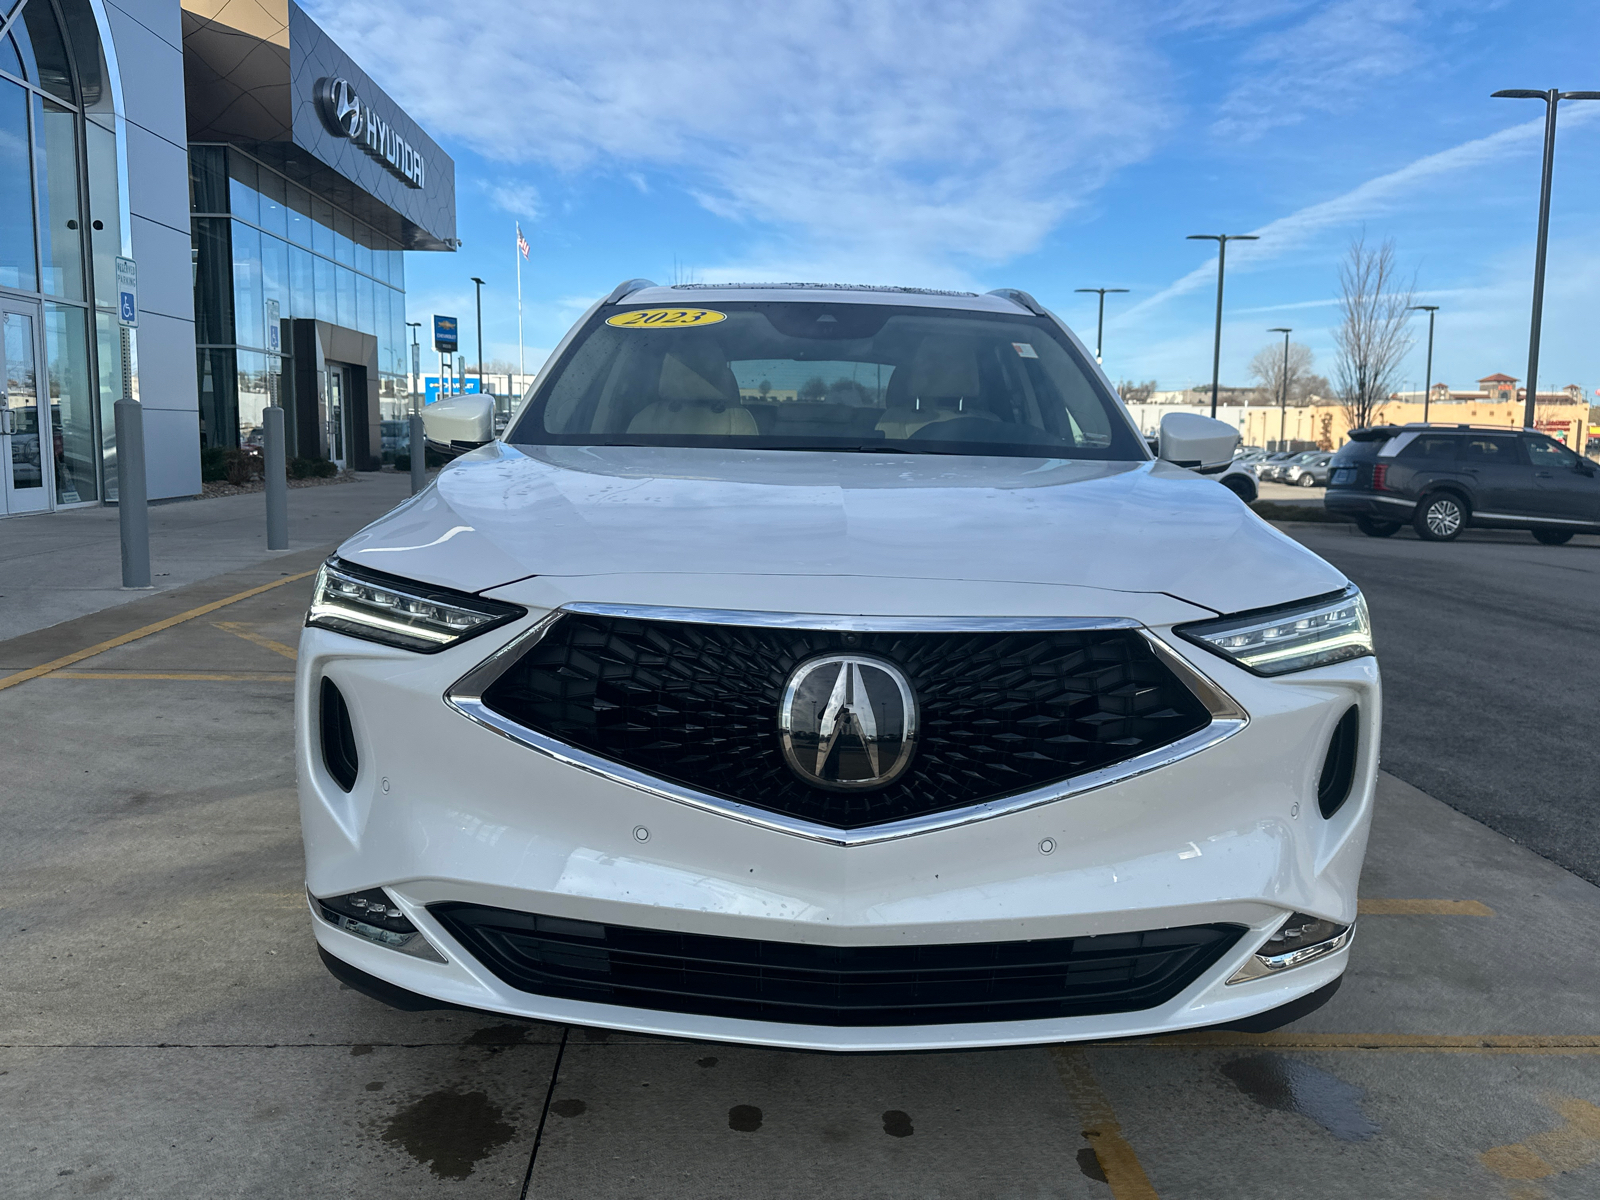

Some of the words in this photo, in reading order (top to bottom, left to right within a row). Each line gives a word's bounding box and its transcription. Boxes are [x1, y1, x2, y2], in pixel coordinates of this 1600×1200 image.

[365, 106, 425, 189] HYUNDAI
[621, 311, 707, 325] 2023
[437, 332, 456, 340] CHEVROLET
